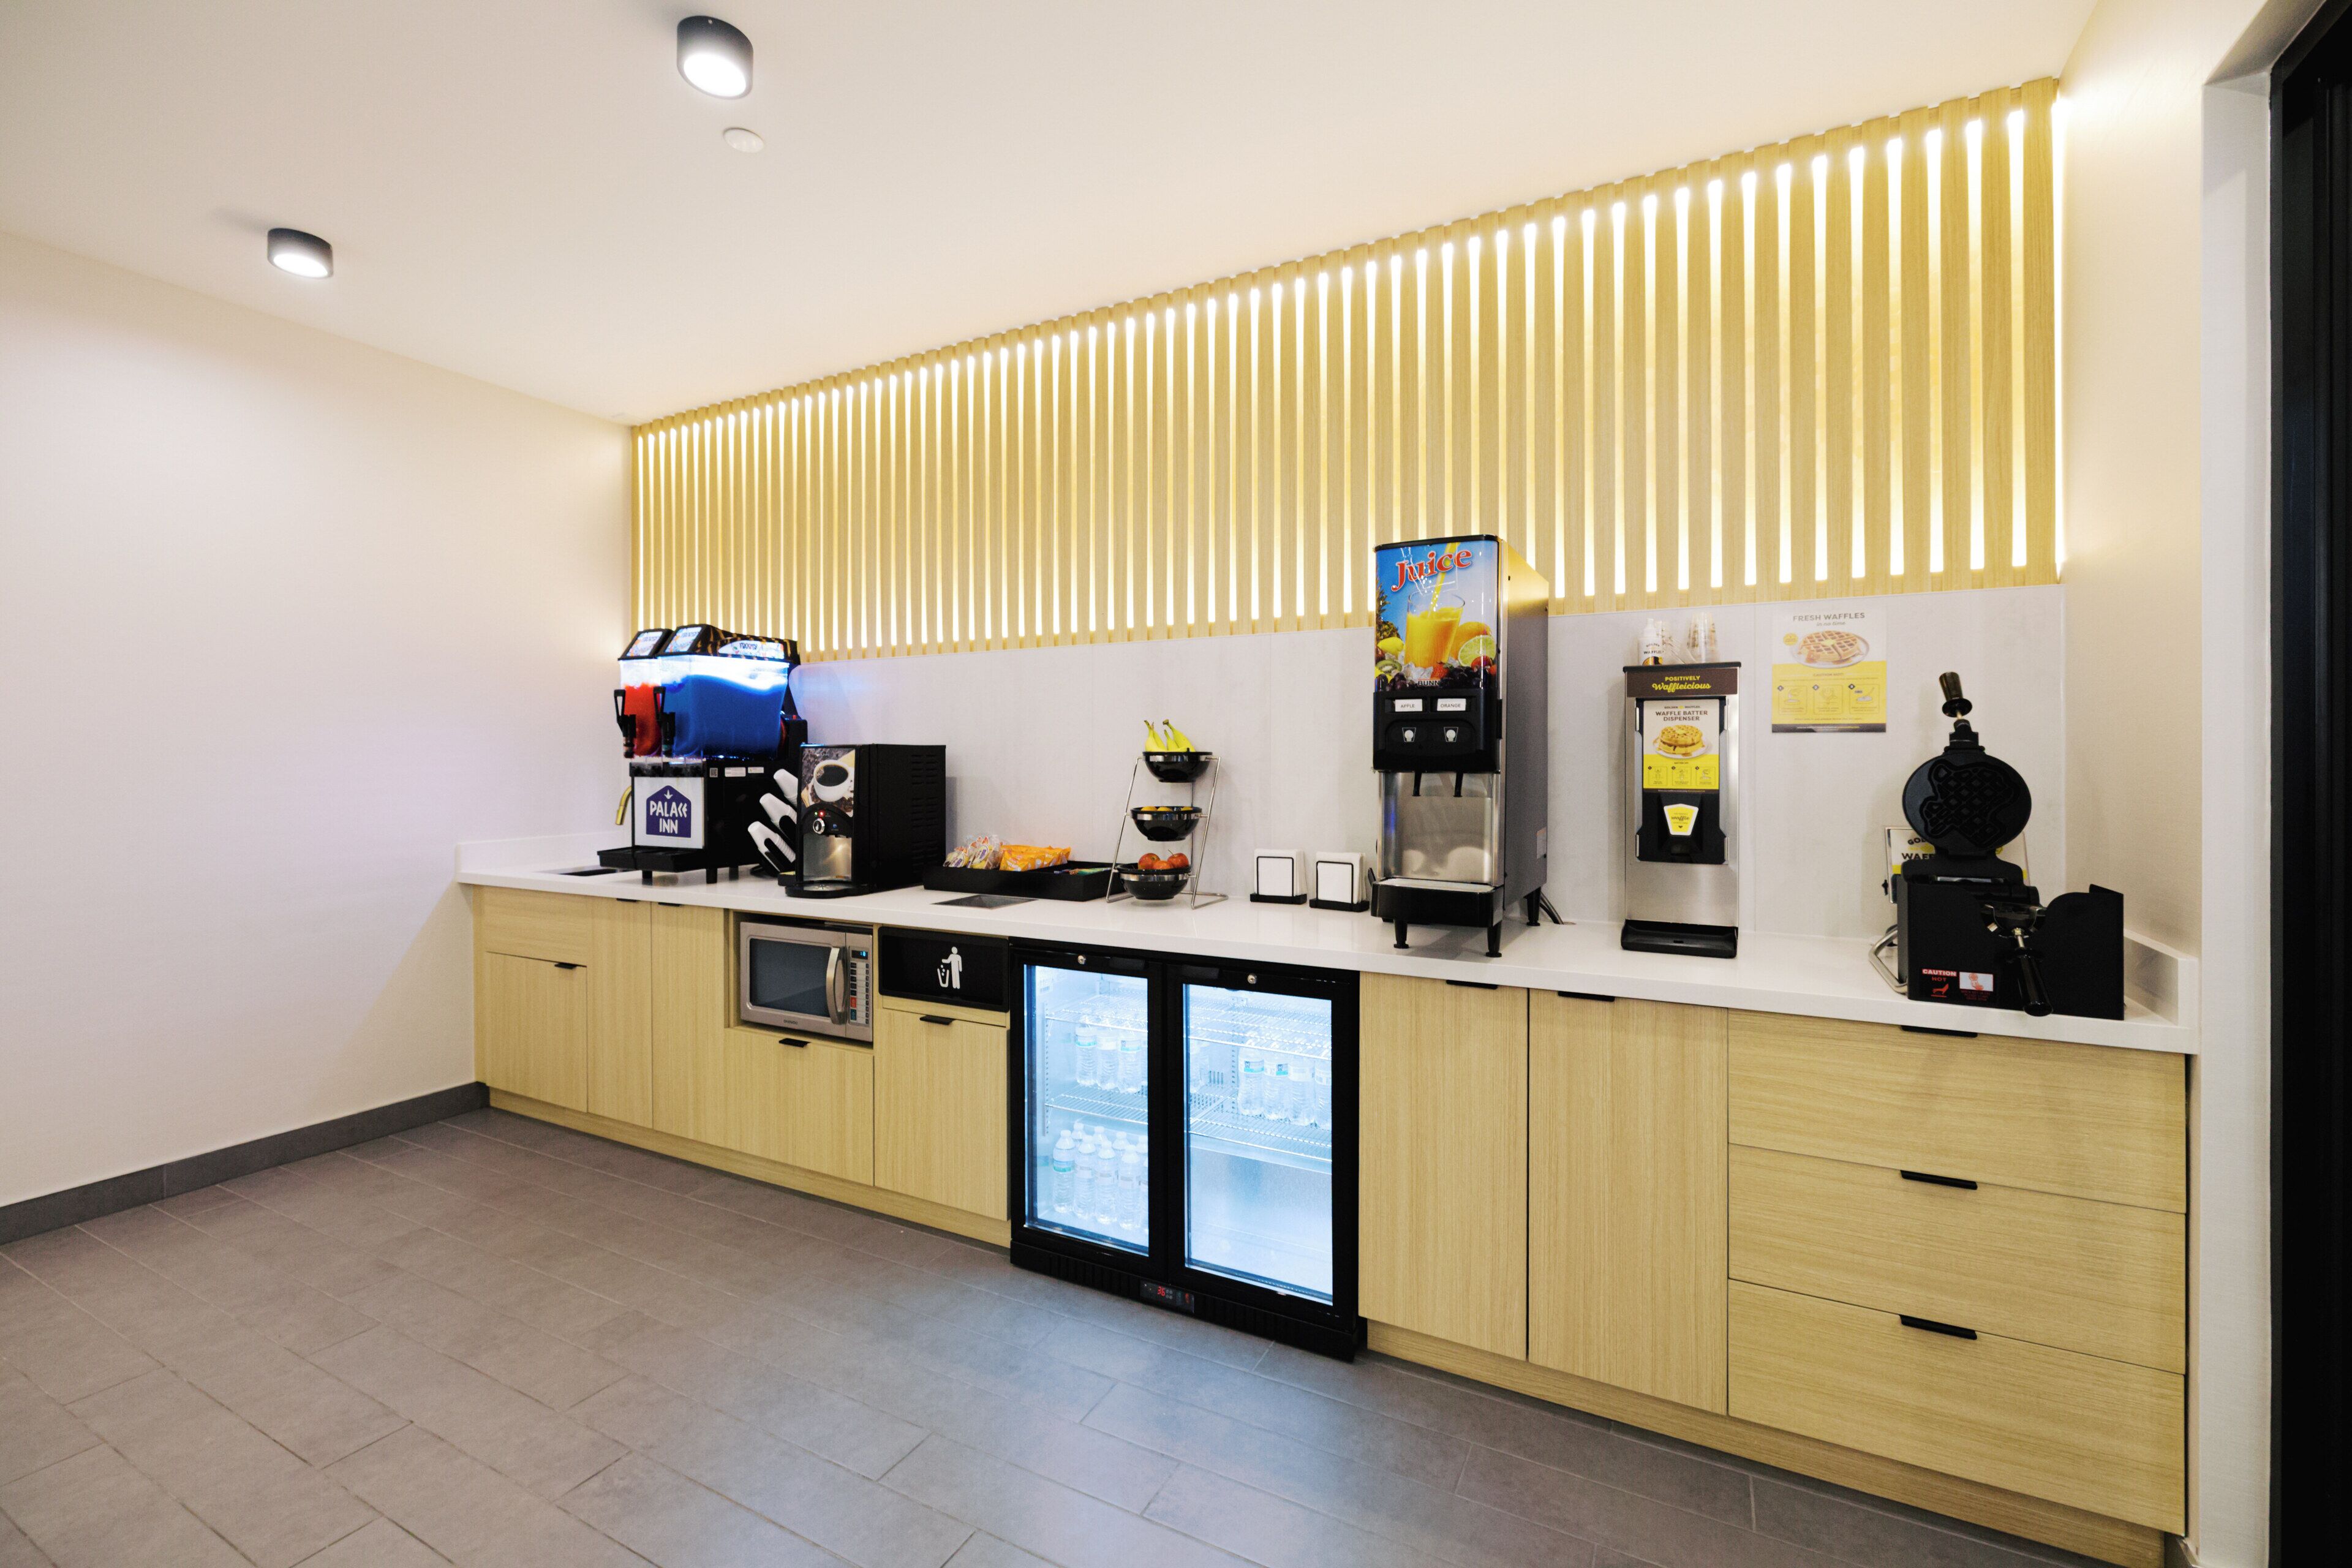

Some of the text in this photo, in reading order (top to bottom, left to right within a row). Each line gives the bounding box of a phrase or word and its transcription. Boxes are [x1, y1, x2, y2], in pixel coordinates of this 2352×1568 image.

[1391, 549, 1472, 592] Juice
[1652, 682, 1711, 693] Waffleicious
[650, 801, 687, 818] PALACE
[659, 818, 678, 834] INN
[1157, 1286, 1166, 1297] 36
